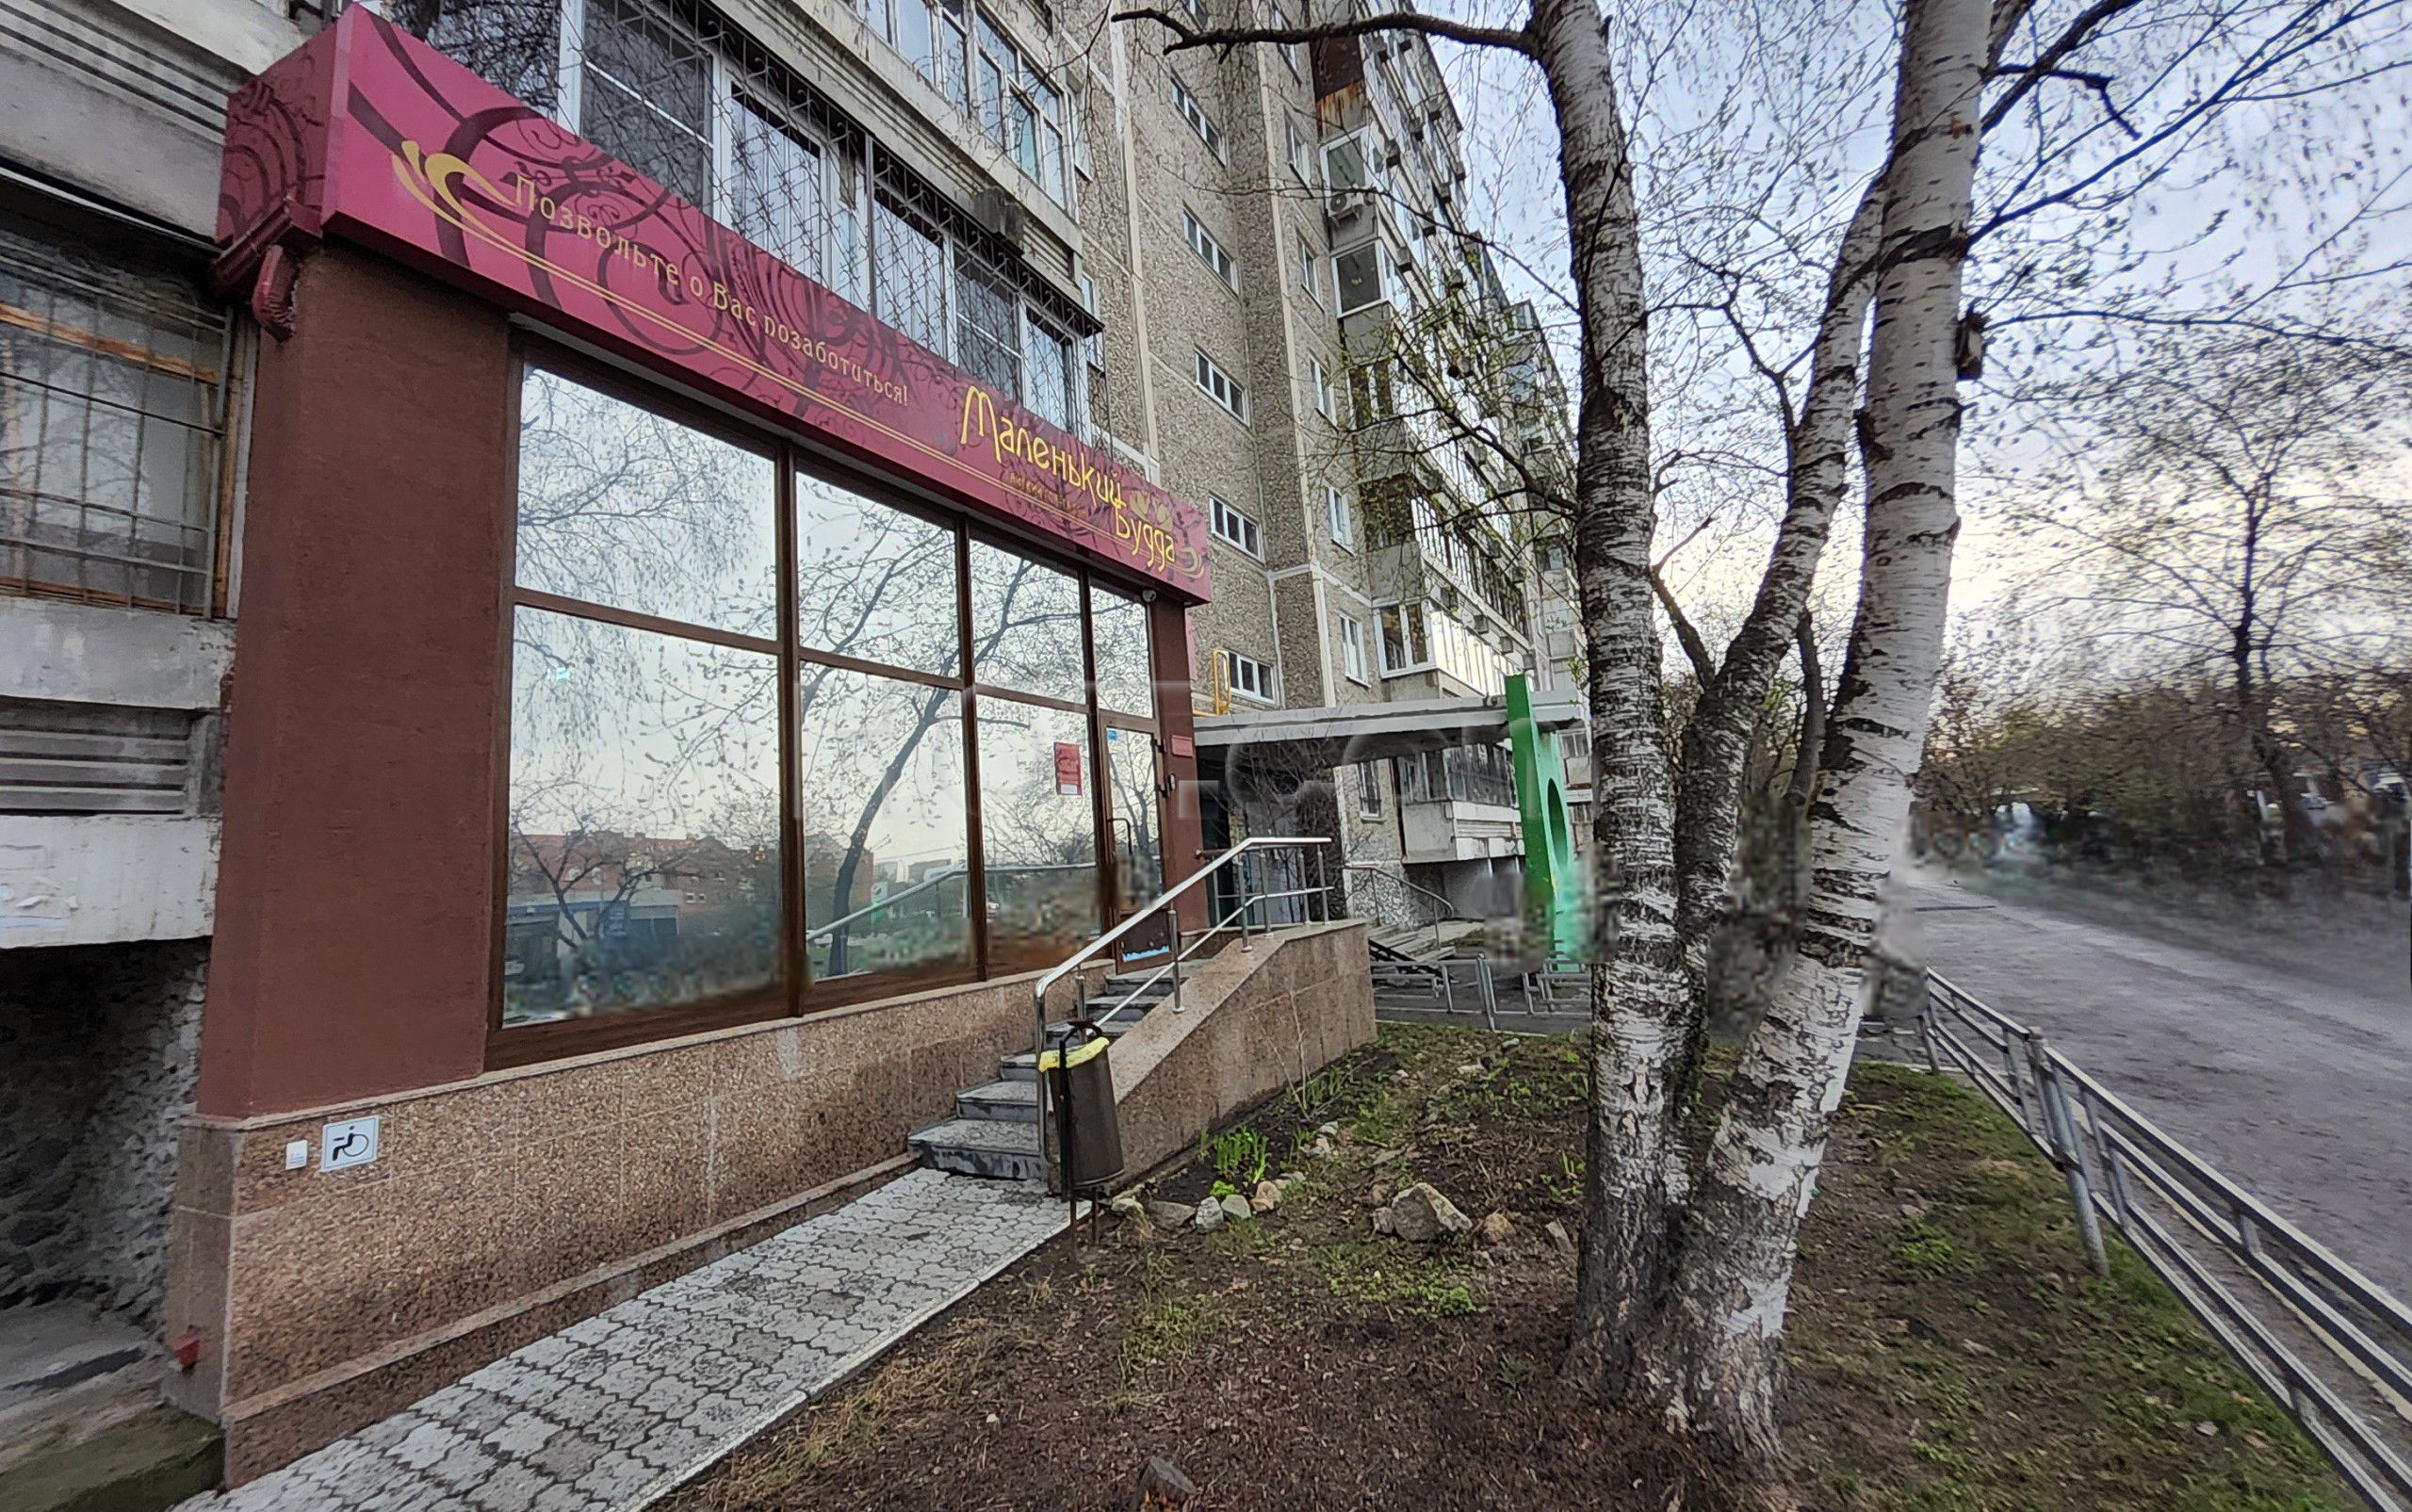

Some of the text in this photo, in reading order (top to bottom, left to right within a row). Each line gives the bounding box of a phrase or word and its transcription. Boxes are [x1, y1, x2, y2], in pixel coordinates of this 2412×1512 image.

[513, 173, 909, 408] Позвольте о Вас позаботиться!
[960, 384, 1126, 510] Маленький
[1115, 501, 1177, 573] Будда
